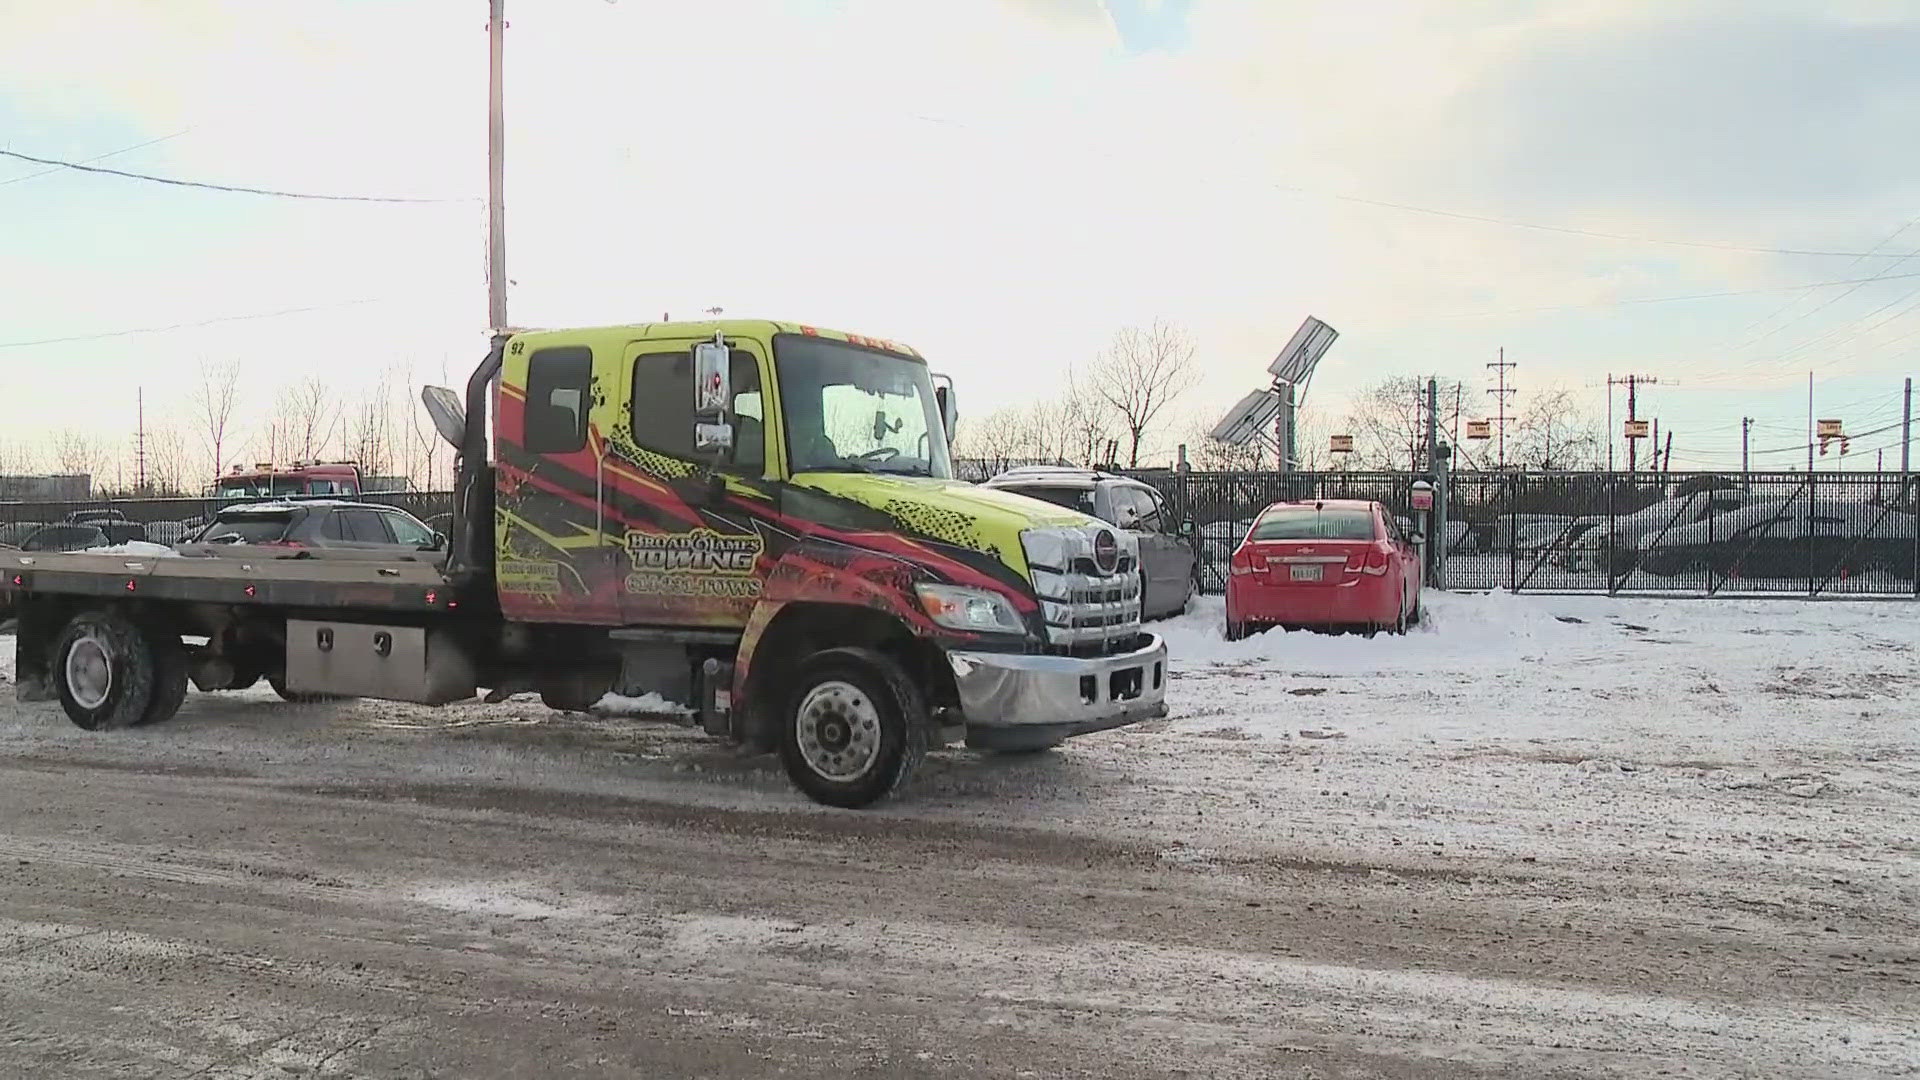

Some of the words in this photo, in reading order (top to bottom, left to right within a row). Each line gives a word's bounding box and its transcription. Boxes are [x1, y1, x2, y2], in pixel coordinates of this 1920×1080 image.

[511, 341, 525, 355] 92
[630, 534, 690, 549] BROAD
[634, 549, 753, 570] TOWING
